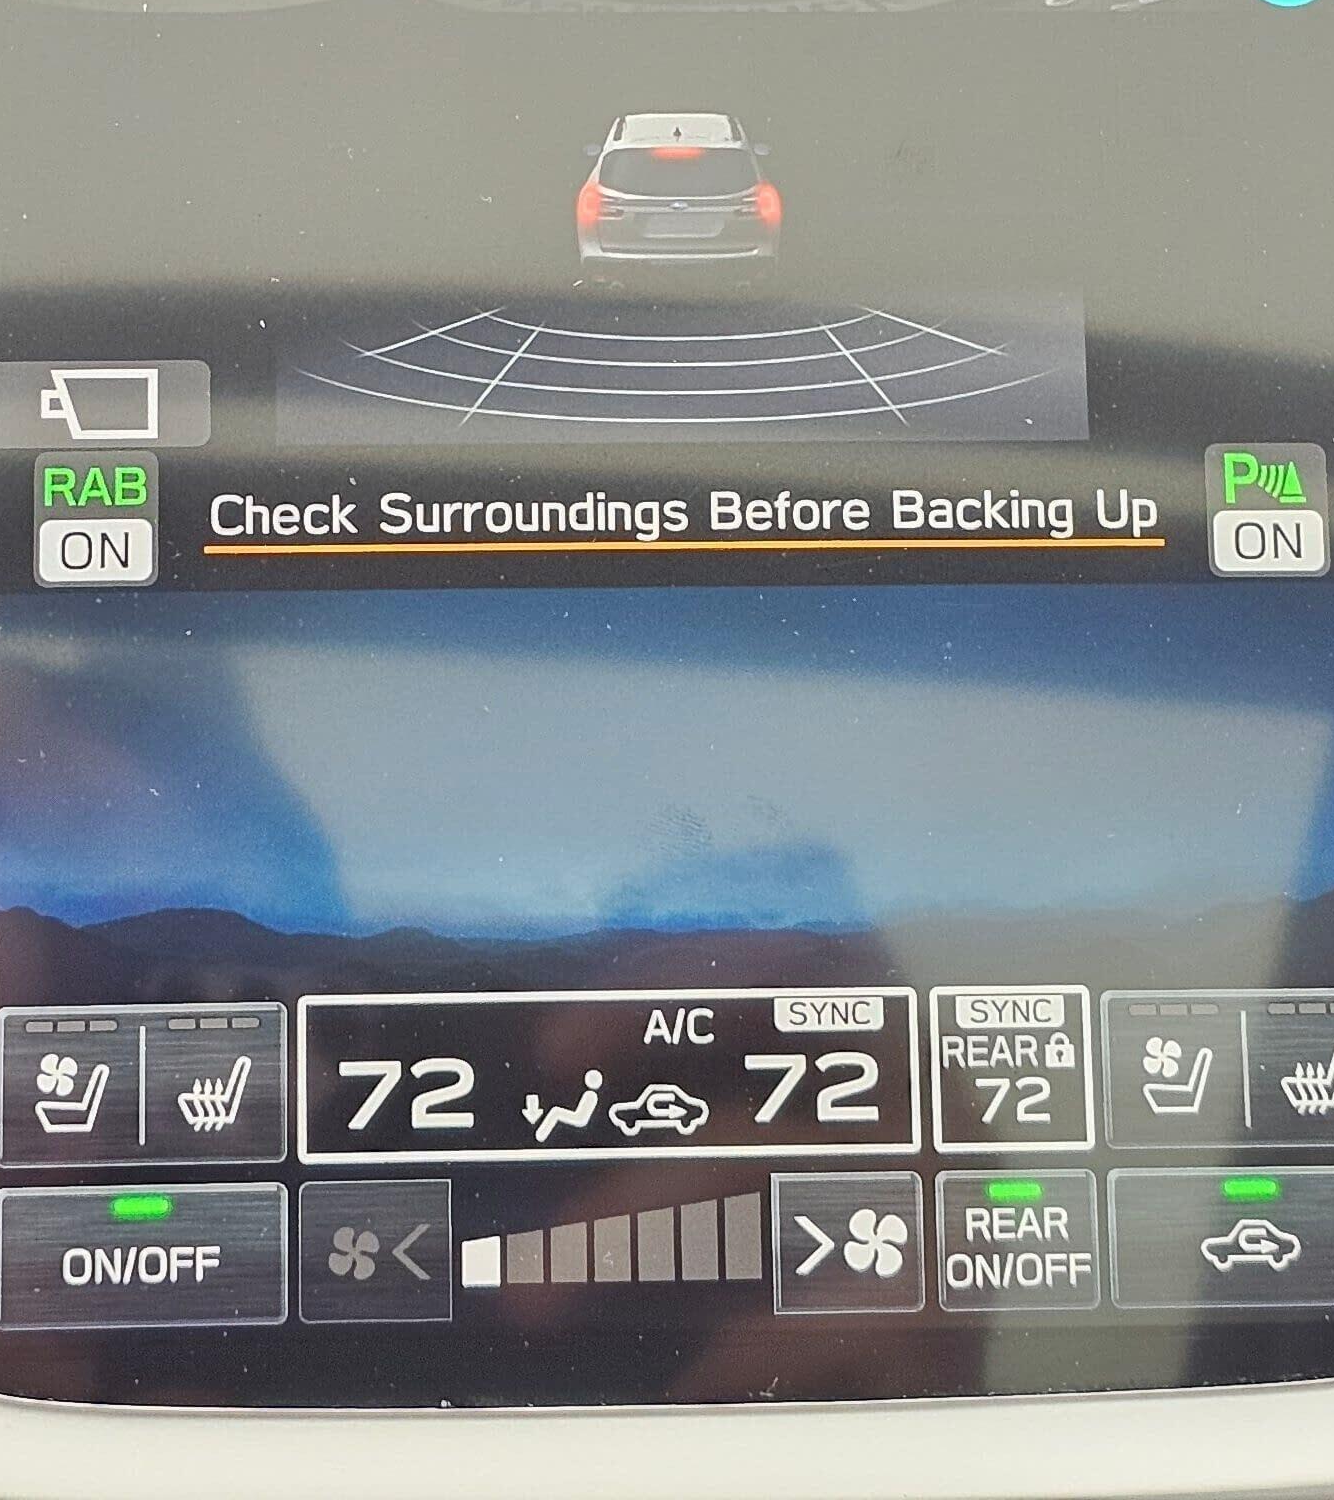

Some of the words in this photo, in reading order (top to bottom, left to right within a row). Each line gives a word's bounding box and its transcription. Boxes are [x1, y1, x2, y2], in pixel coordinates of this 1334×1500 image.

[43, 467, 147, 506] RAB
[209, 493, 357, 536] Check
[379, 492, 689, 542] Surroundings
[710, 491, 870, 531] Before
[892, 489, 1074, 539] Backing
[1096, 489, 1157, 537] Up
[60, 531, 130, 570] ON
[1234, 522, 1302, 560] ON
[643, 1007, 714, 1045] A/C
[788, 1002, 871, 1026] SYNC
[969, 998, 1052, 1024] SYNC
[942, 1036, 1039, 1070] REAR
[339, 1058, 474, 1131] 72
[744, 1052, 879, 1124] 72
[974, 1076, 1051, 1124] 72
[965, 1207, 1069, 1240] REAR
[62, 1246, 220, 1286] ON/OFF
[946, 1253, 1091, 1292] ON/OFF
